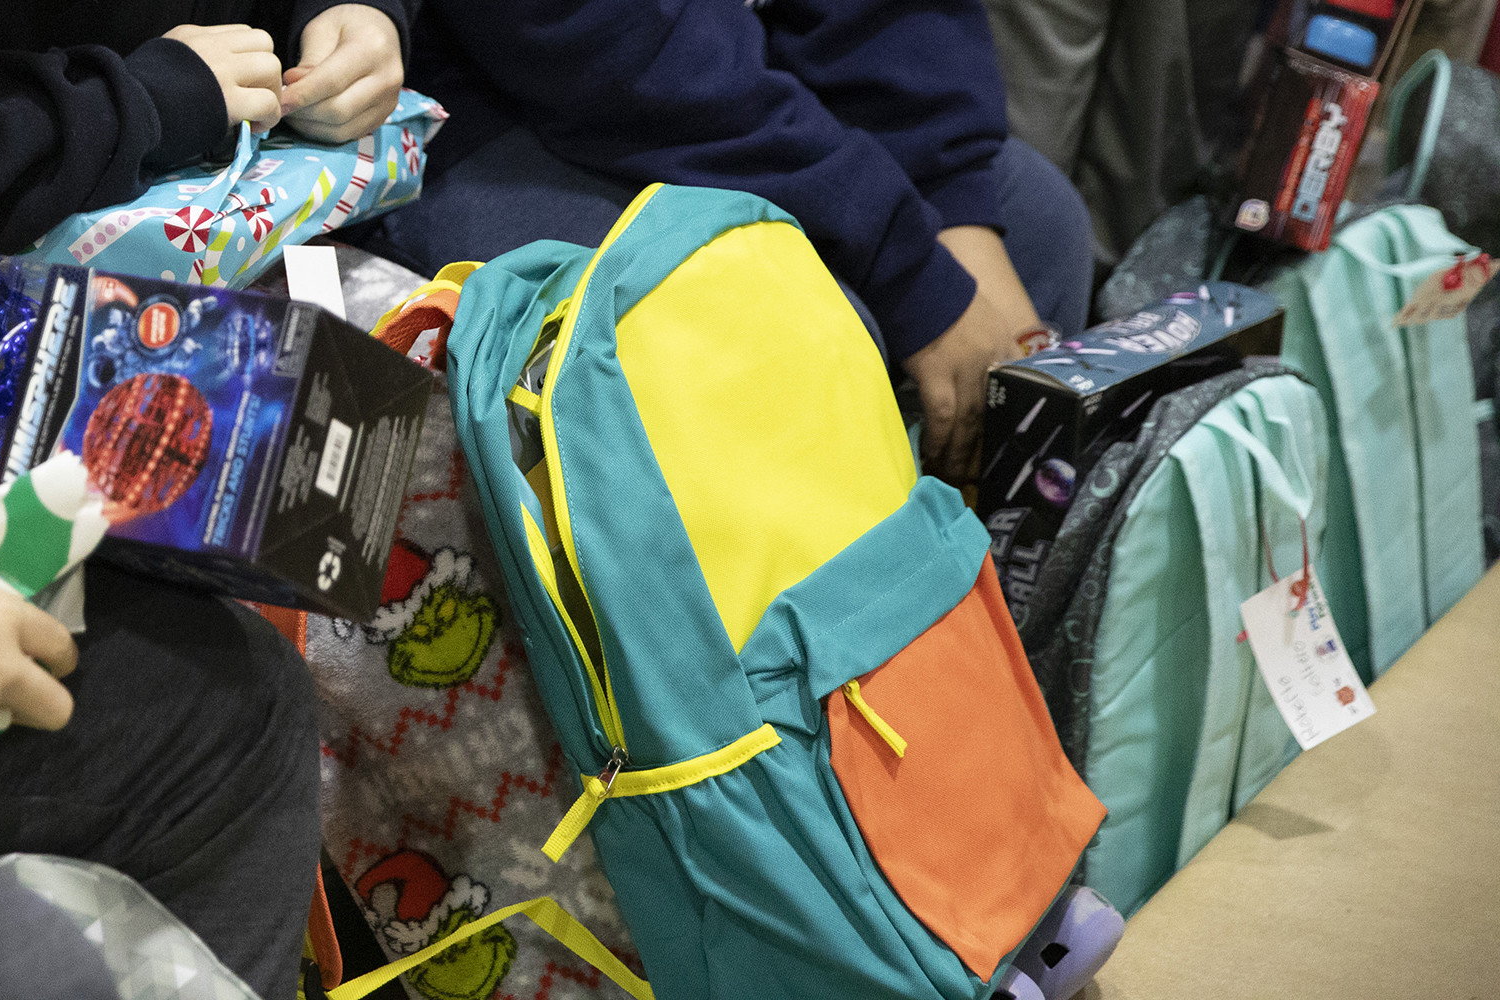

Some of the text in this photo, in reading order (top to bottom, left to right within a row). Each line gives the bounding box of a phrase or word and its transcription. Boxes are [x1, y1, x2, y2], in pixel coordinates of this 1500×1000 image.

[1292, 102, 1349, 221] DERBY
[2, 277, 78, 480] UMISPHERE
[212, 490, 238, 547] TRICKS
[225, 455, 245, 492] AND
